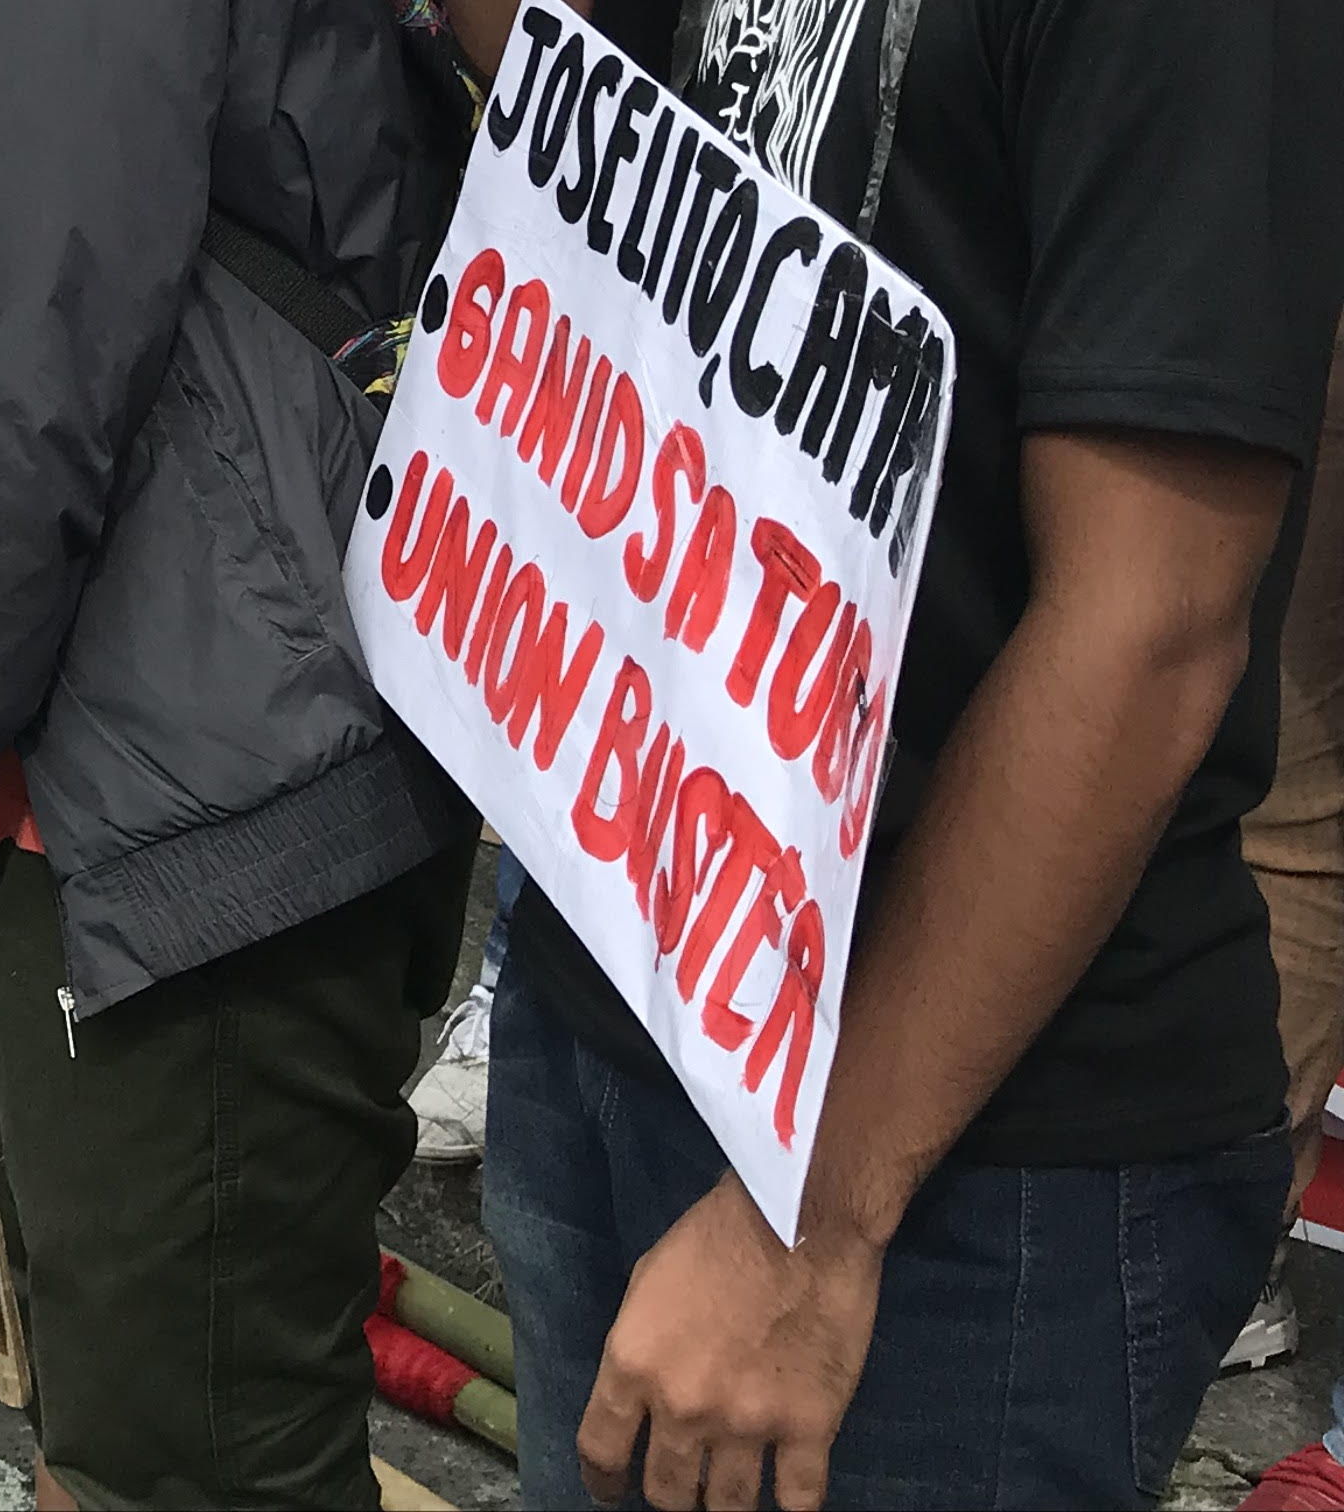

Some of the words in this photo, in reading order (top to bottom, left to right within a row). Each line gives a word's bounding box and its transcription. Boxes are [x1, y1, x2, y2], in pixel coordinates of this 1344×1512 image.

[623, 419, 737, 655] SA
[379, 449, 609, 774] UNION
[569, 653, 830, 1153] BUSTER
